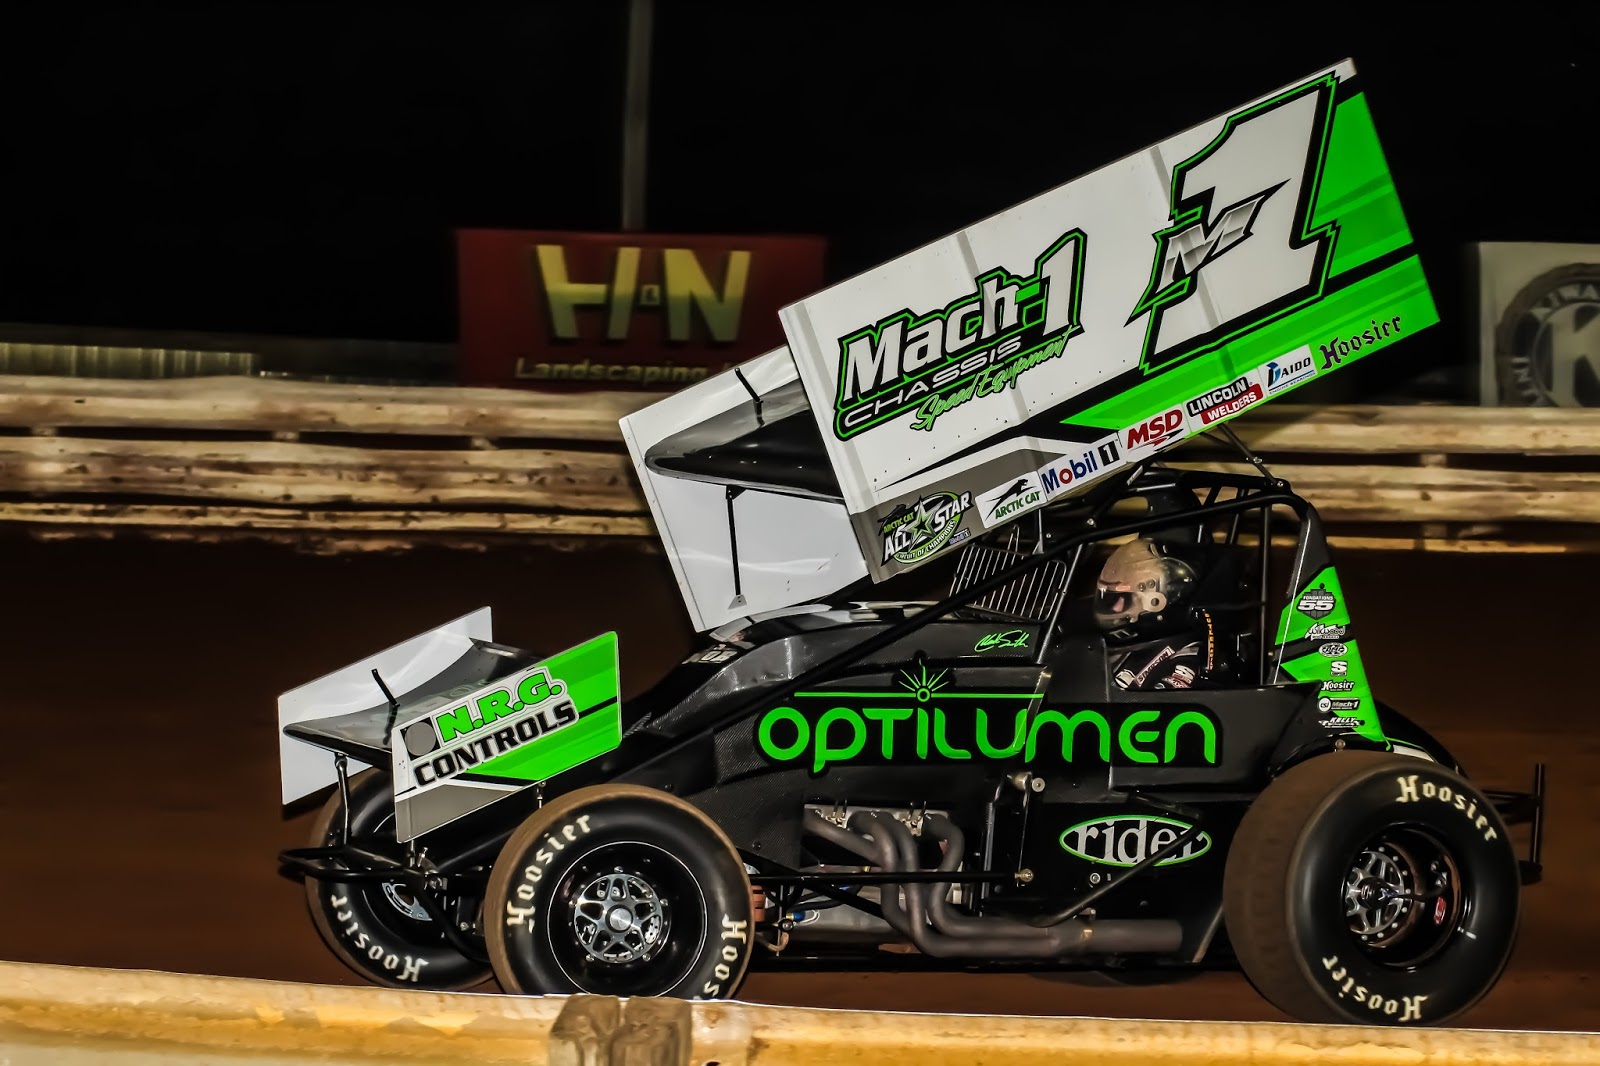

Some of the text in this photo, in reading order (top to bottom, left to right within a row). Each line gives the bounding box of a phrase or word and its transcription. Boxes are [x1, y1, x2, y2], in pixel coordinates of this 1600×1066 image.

[1143, 76, 1332, 366] 1
[1152, 193, 1268, 297] M
[841, 232, 1084, 402] Mach-1
[1318, 314, 1401, 370] Hoosier
[515, 357, 707, 384] Landscaping
[844, 335, 1022, 428] CHASSIS
[911, 325, 1081, 430] Speed Equipment
[1190, 379, 1248, 415] LINCOLN
[1267, 357, 1312, 388] DAIDO
[1126, 409, 1183, 450] MSD
[1207, 391, 1258, 421] WELDERS
[1041, 443, 1117, 494] Mobil 1
[883, 512, 914, 533] ARCTIC CAT
[884, 530, 911, 562] ALL
[934, 491, 971, 533] STAR
[994, 490, 1041, 520] ARCTIC CAT
[925, 520, 957, 553] CHAMPIONS
[1298, 600, 1334, 611] 55
[1321, 680, 1355, 690] Hoosier
[1331, 660, 1347, 672] S
[436, 672, 562, 743] N.R.G.
[413, 700, 576, 787] CONTROLS
[1396, 775, 1498, 841] Hoosier
[506, 814, 591, 933] Hoosier
[331, 894, 429, 982] Hoosier
[700, 914, 748, 998] Hoos
[1322, 955, 1429, 1022] Hoosier
